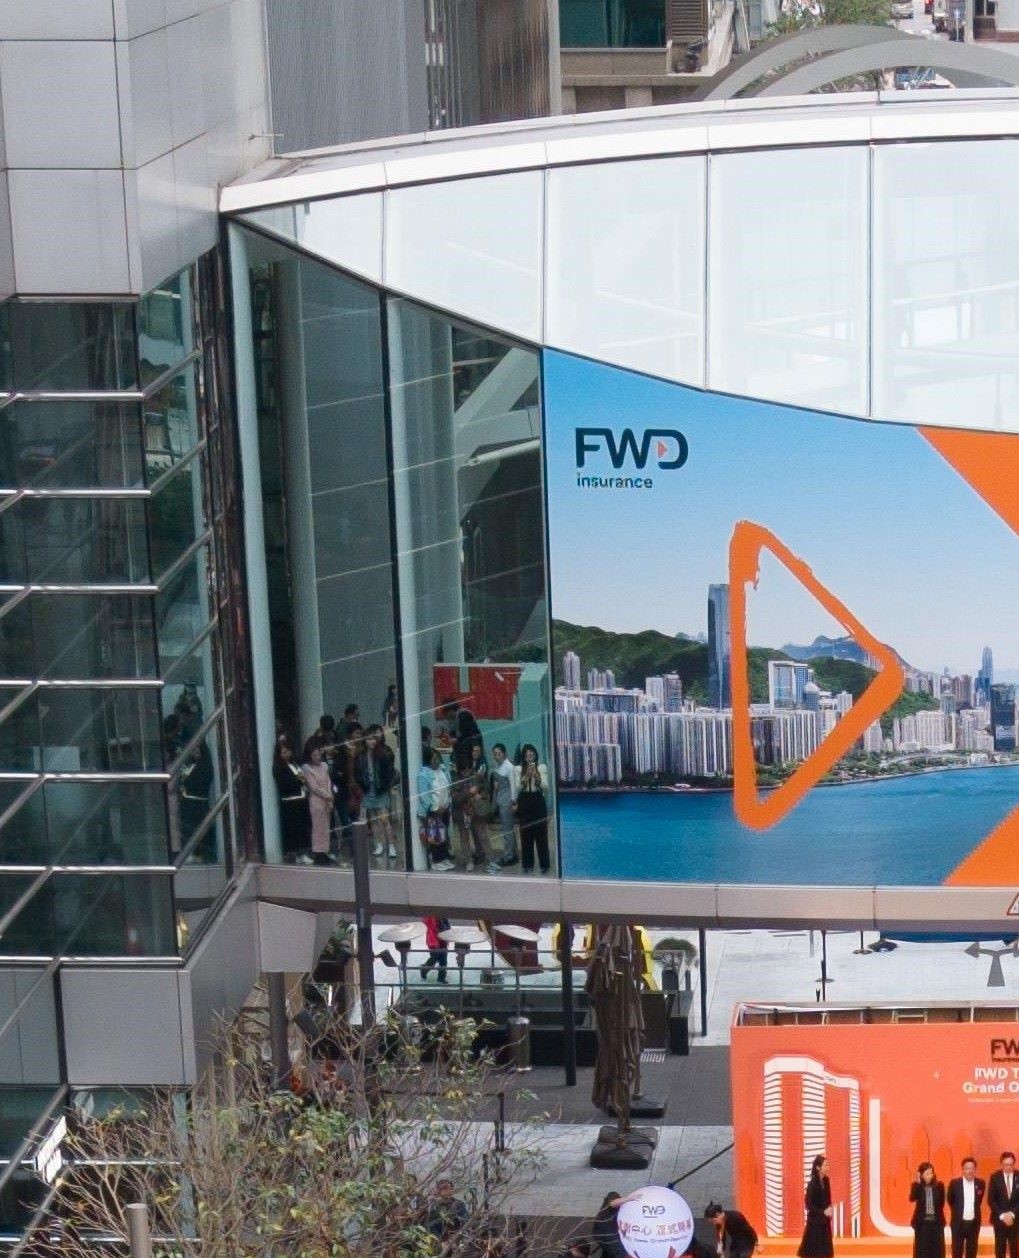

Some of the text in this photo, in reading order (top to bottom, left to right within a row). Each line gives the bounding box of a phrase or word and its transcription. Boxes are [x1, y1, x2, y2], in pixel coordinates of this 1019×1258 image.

[575, 428, 689, 469] FWD
[576, 472, 653, 489] insurance
[974, 1067, 1009, 1080] FWD
[962, 1082, 1005, 1094] Grand
